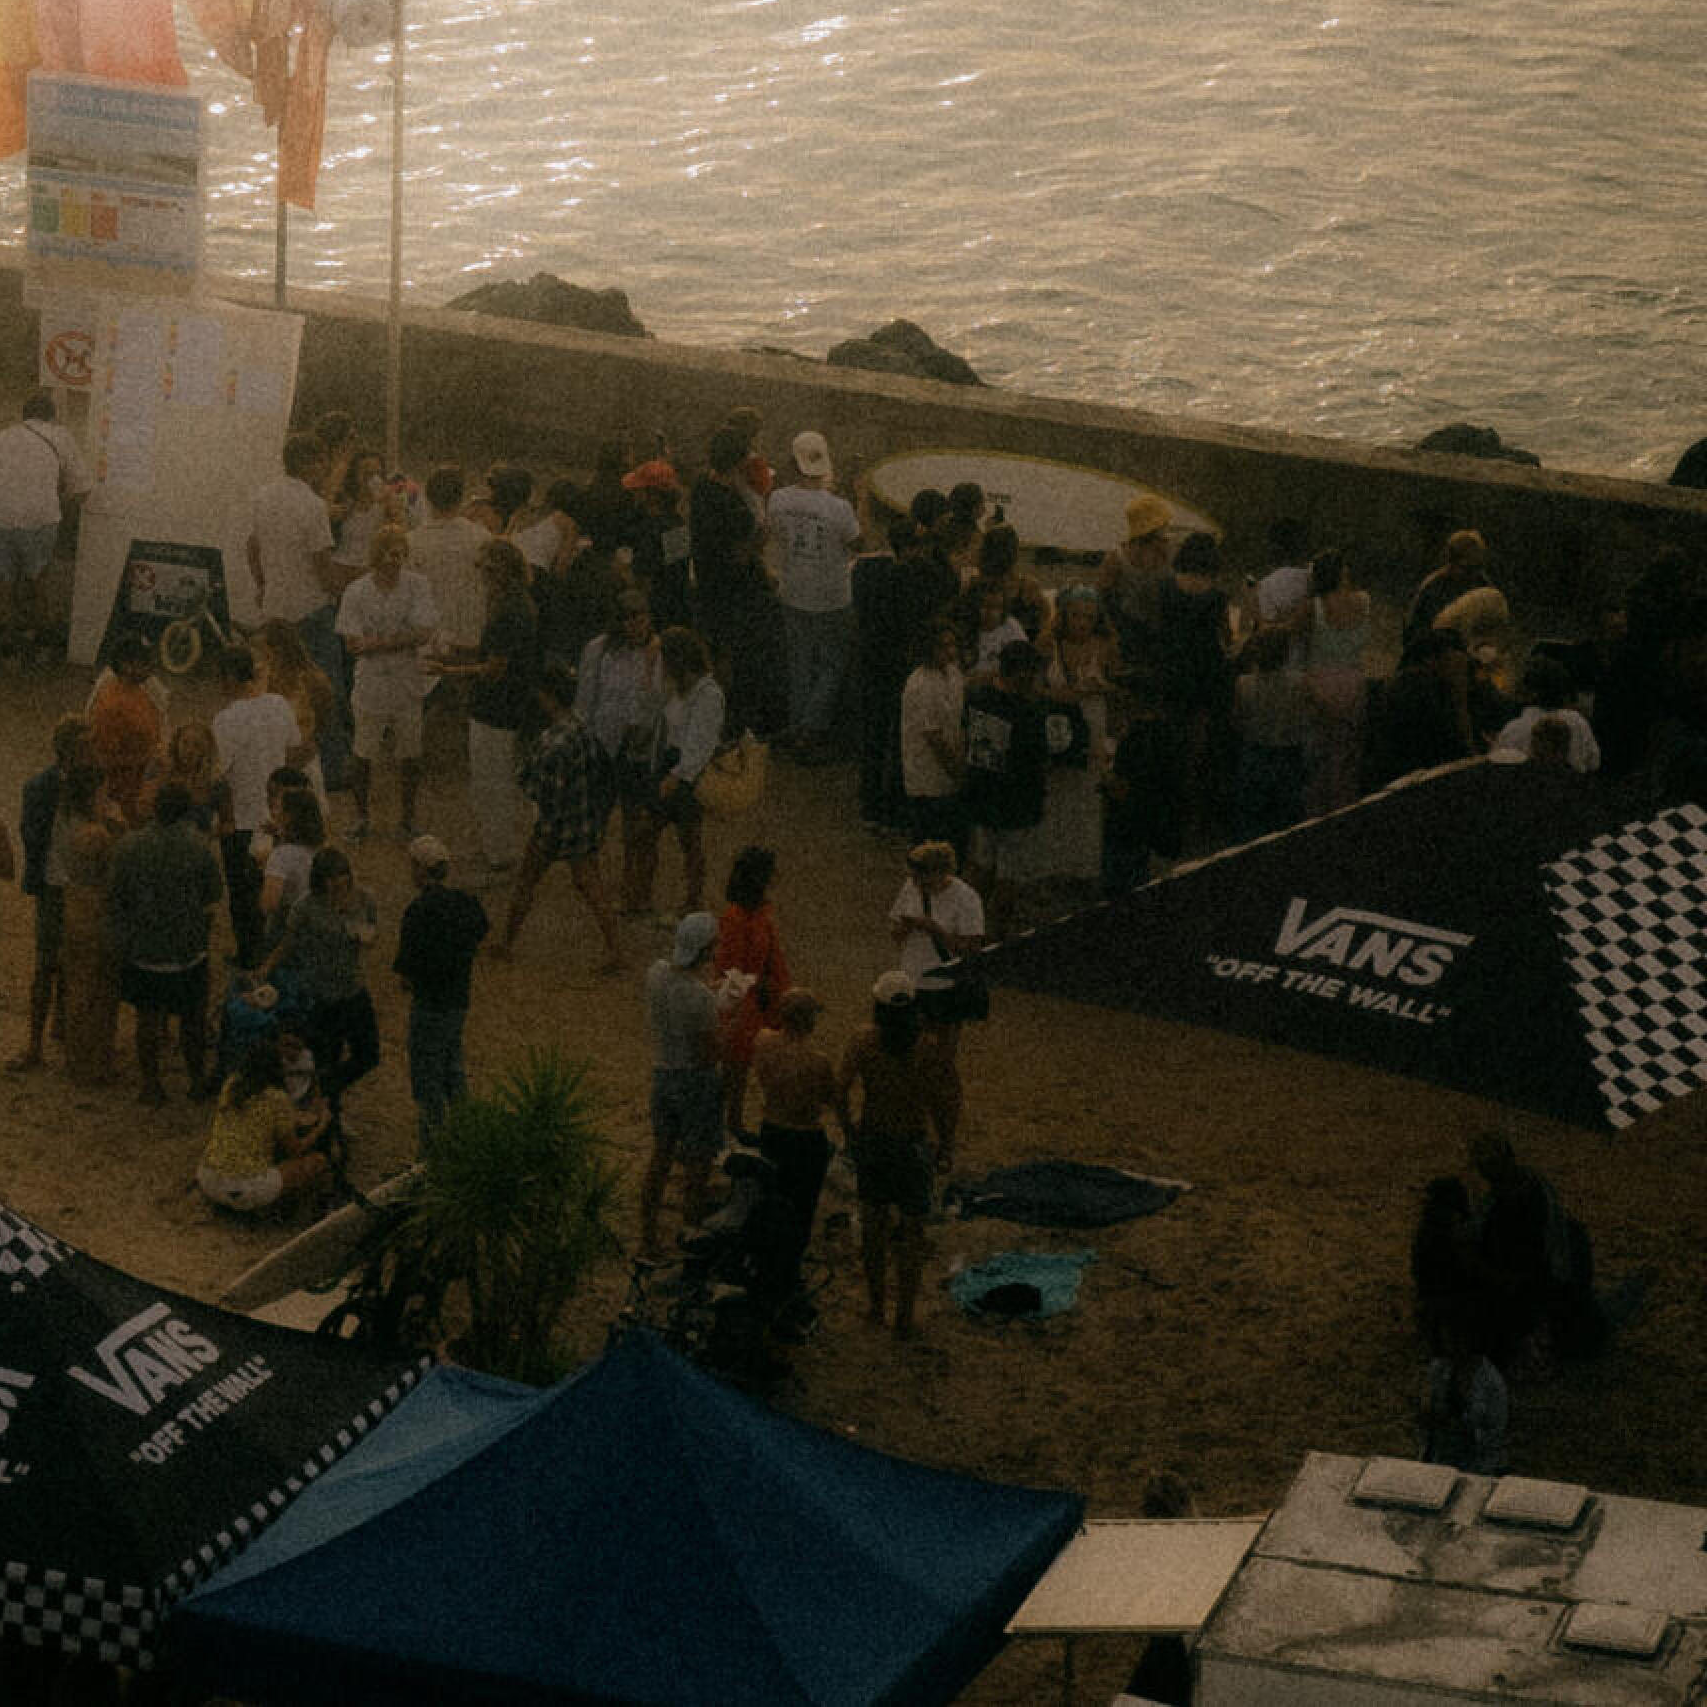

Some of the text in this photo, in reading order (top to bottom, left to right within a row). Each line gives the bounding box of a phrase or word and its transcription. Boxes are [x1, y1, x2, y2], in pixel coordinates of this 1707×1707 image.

[1206, 953, 1452, 1025] "OFF THE WALL"
[1274, 897, 1477, 986] VANS
[67, 1300, 220, 1417] VANS
[128, 1354, 274, 1464] "OFF THE WALL"
